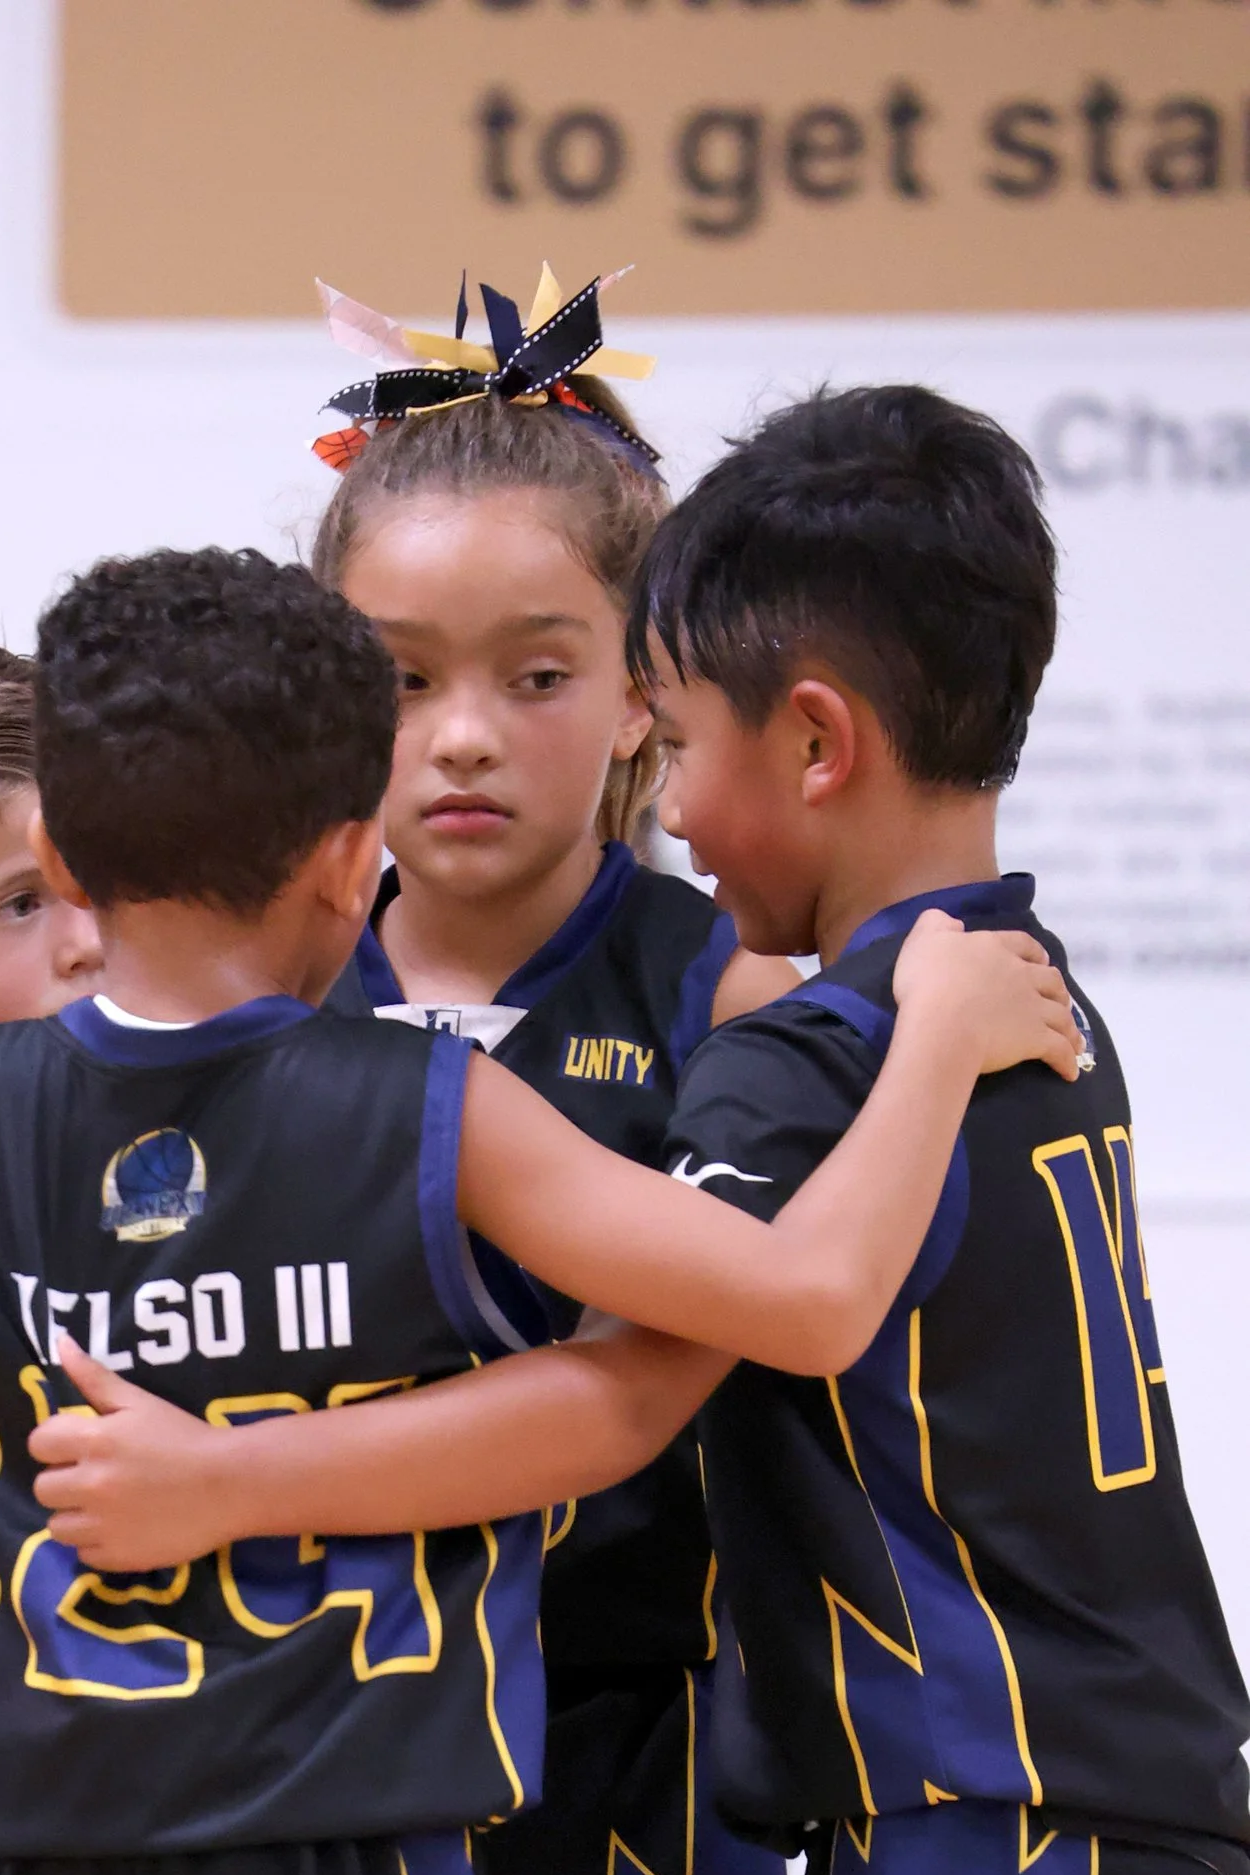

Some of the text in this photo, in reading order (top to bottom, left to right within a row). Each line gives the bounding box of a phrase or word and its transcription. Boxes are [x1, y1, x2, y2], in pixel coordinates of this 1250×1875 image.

[476, 78, 1250, 240] to get sta
[564, 1036, 654, 1084] UNITY
[273, 1261, 352, 1352] III
